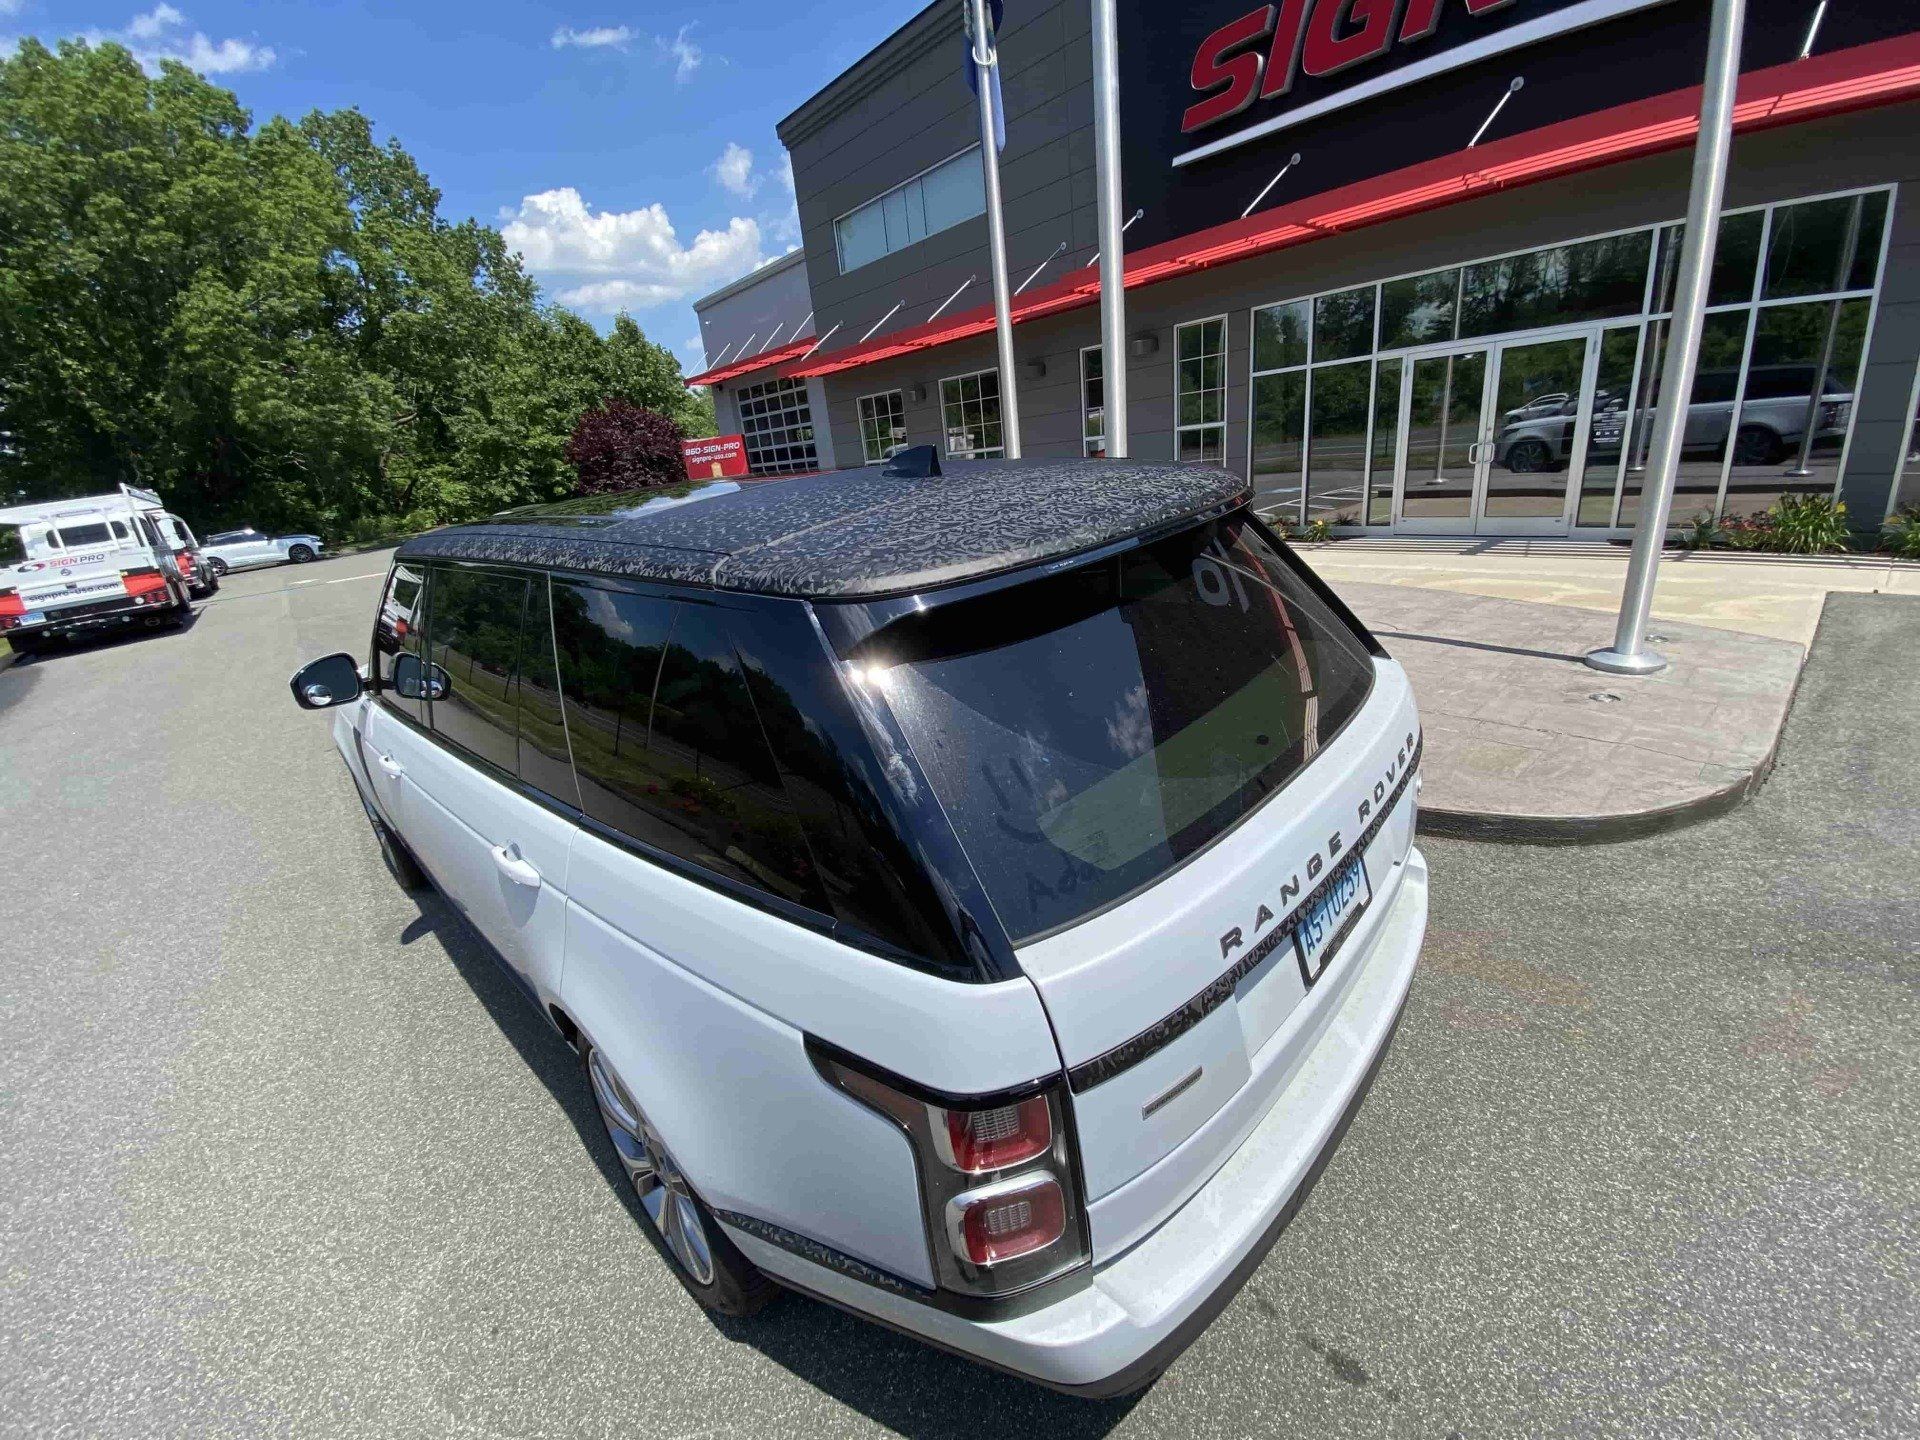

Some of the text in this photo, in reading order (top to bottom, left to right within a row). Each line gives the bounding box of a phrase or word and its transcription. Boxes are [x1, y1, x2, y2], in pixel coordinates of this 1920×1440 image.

[49, 553, 105, 568] SIGN PRO
[28, 582, 119, 602] signpro-usa.com
[1219, 732, 1414, 960] RANGE ROVER
